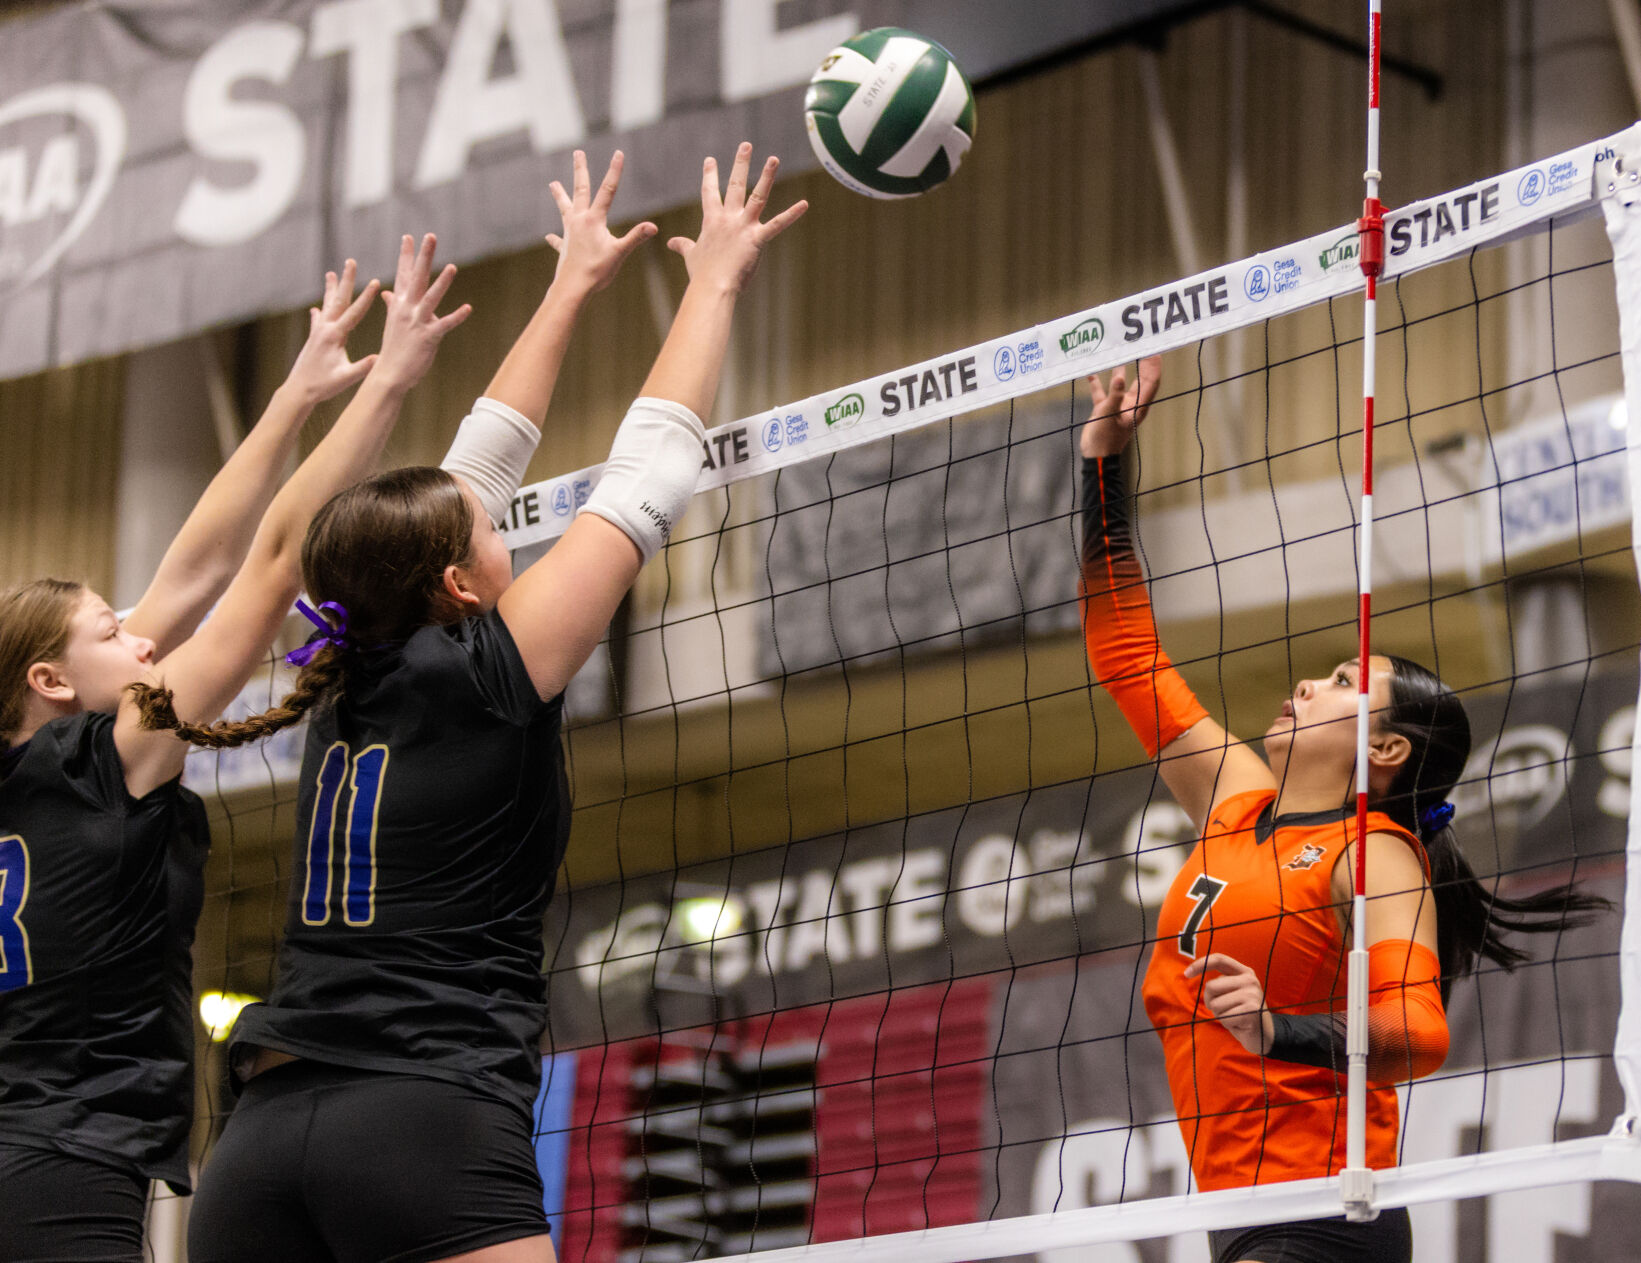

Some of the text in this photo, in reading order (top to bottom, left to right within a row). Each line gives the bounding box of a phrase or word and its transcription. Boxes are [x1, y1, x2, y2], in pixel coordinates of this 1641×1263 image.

[1549, 161, 1573, 175] Gesa
[1548, 168, 1578, 185] Credit
[1390, 183, 1500, 256] STATE
[1273, 259, 1295, 271] Gesa
[1273, 266, 1302, 282] Credit
[1274, 280, 1299, 294] Union
[1066, 276, 1229, 351] WIAA STATE
[1018, 341, 1039, 354] Gesa
[1018, 349, 1044, 364] Credit
[1020, 361, 1043, 374] Union
[829, 356, 977, 423] WIAA STATE
[785, 414, 803, 426] Gesa
[786, 421, 809, 436] Credit
[787, 433, 808, 446] Union
[302, 740, 389, 926] 11
[1178, 873, 1228, 960] 7
